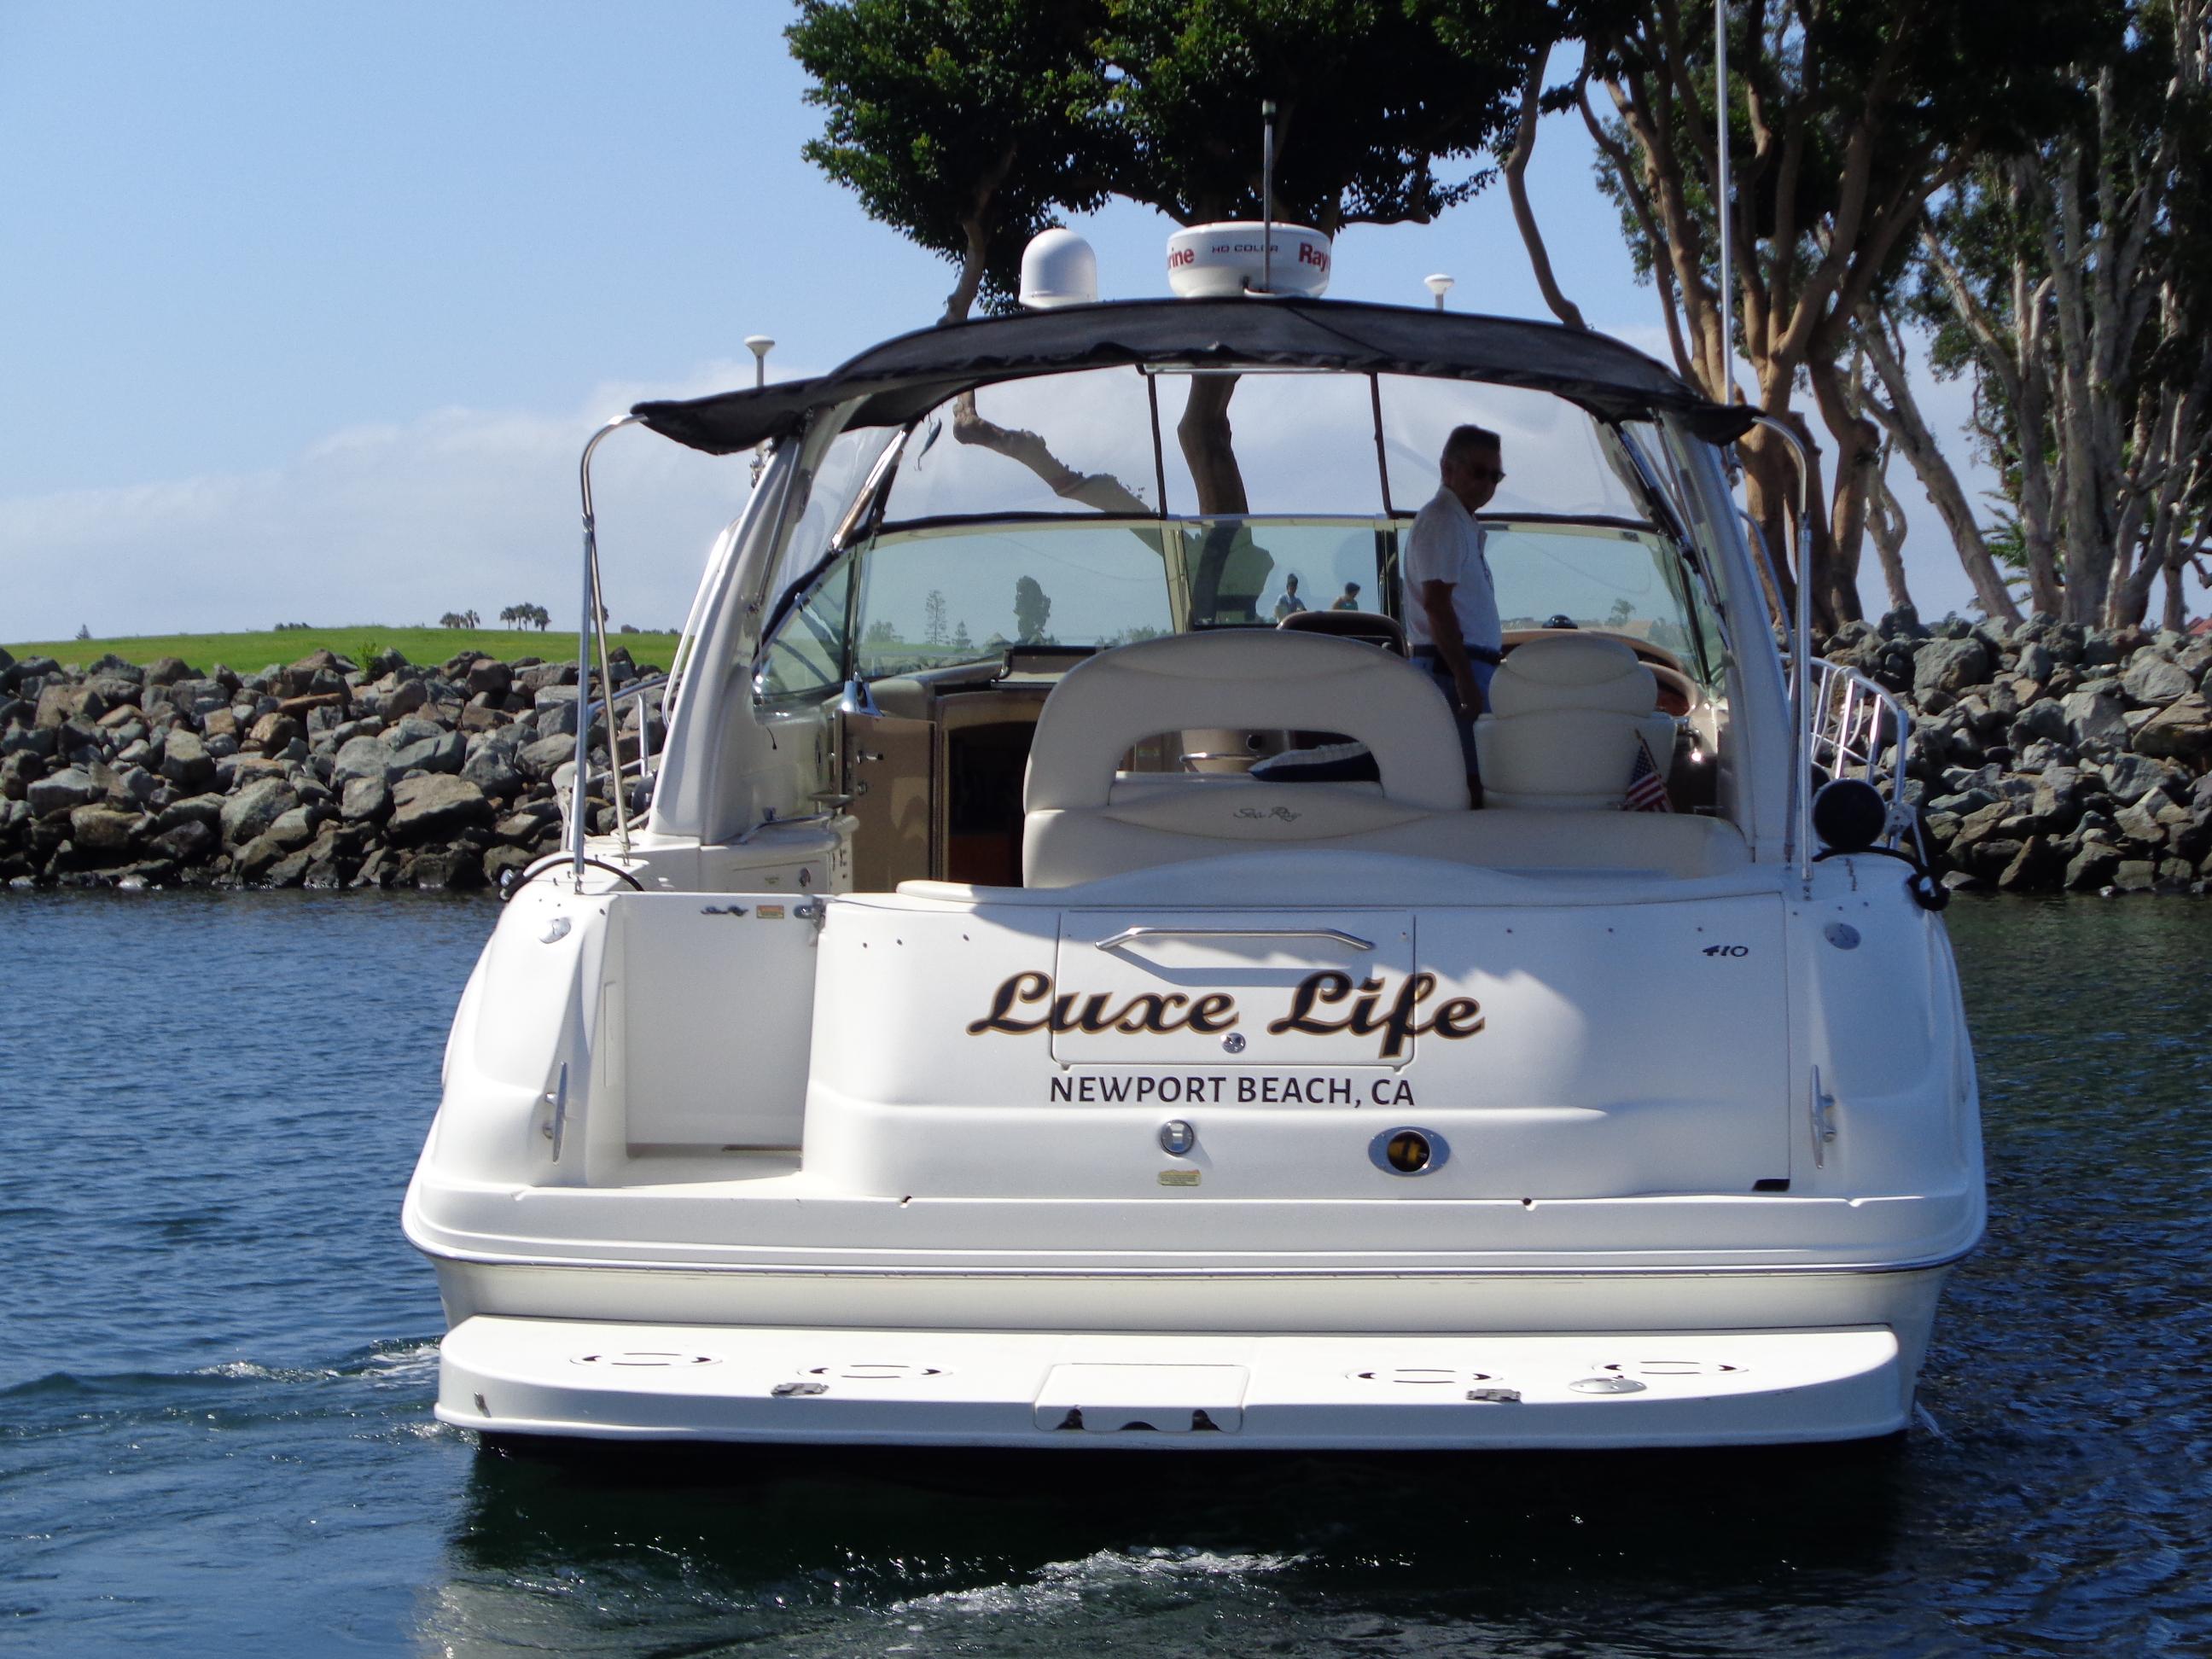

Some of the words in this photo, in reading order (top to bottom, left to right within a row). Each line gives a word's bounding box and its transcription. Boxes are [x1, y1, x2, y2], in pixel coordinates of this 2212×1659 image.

[1703, 945, 1749, 958] 410
[965, 969, 1240, 1038] Luxe
[1266, 969, 1487, 1059] Life
[1050, 1076, 1226, 1103] NEWPORT
[1237, 1077, 1361, 1109] BEACH,
[1371, 1079, 1415, 1106] CA
